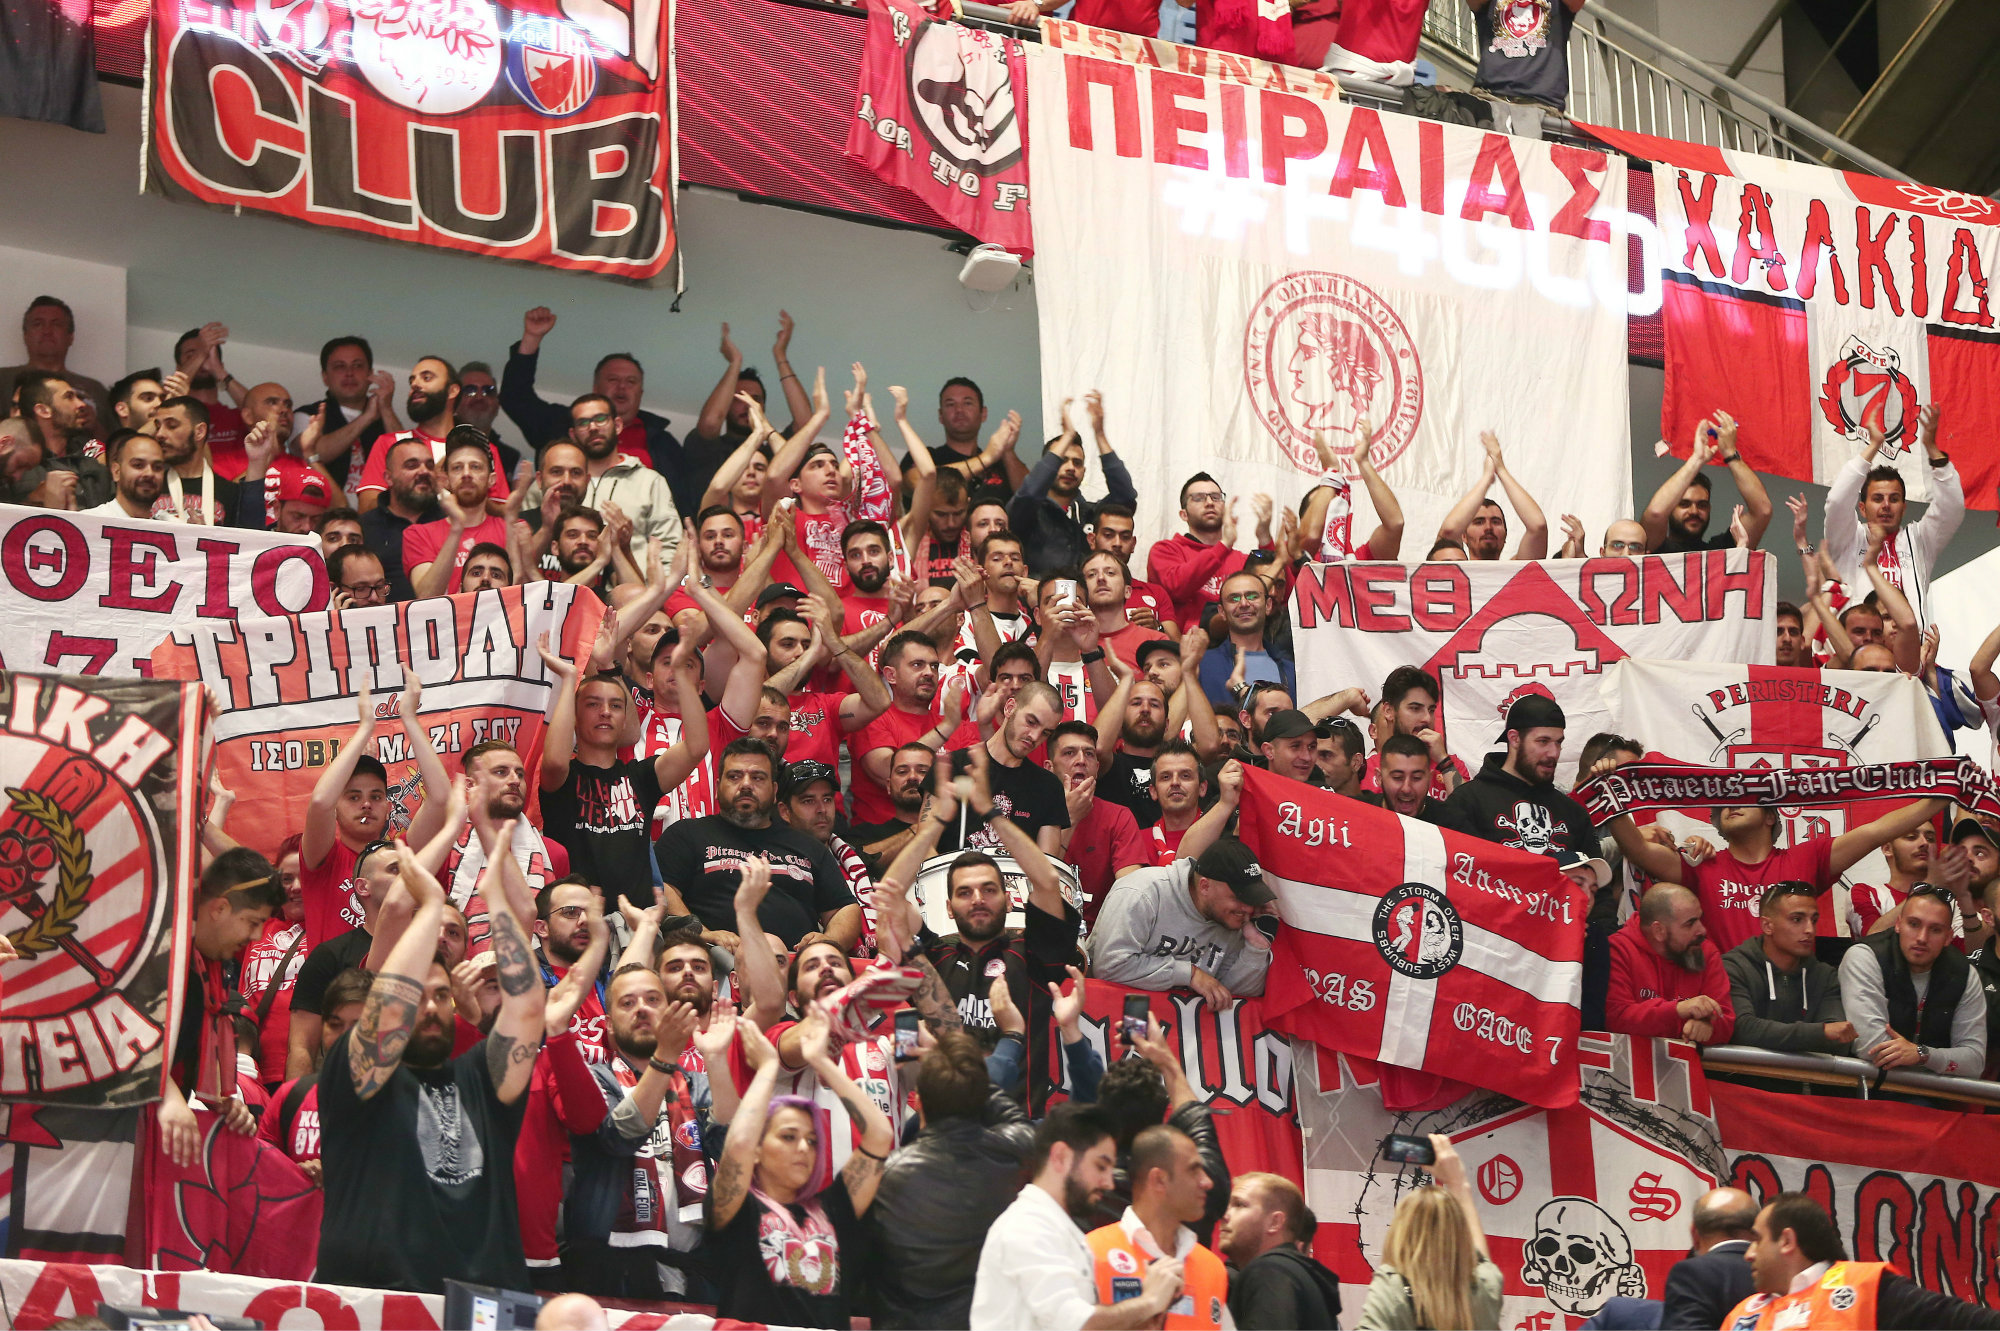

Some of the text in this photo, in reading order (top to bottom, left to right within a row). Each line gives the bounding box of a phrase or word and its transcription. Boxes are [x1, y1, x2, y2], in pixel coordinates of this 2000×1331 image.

[165, 23, 668, 266] CLUB
[1064, 54, 1612, 244] ΠΕΙΡΑΙΑΣ
[1677, 169, 2000, 329] ΧΑΛΚΙΔ
[1856, 345, 1888, 367] GATE
[1853, 368, 1891, 433] 7
[176, 581, 578, 712] ΤΡΙΠΟΛΗ
[0, 675, 174, 789] ΙΚΗ
[1706, 679, 1870, 720] PERISTERI
[252, 734, 347, 771] ΙΣΟΒΙ
[472, 717, 522, 754] ΣΟΥ
[1596, 771, 1746, 814] Piraeus
[1759, 768, 1841, 804] Fan
[1852, 761, 1938, 791] Club
[1277, 801, 1353, 848] Agii
[1453, 852, 1575, 926] Anargiri
[1377, 886, 1460, 975] THE STORM OVER WEST SUBURBS
[1453, 1001, 1563, 1066] GATE 7
[634, 1169, 649, 1197] FINAL
[636, 1197, 651, 1222] FOUR
